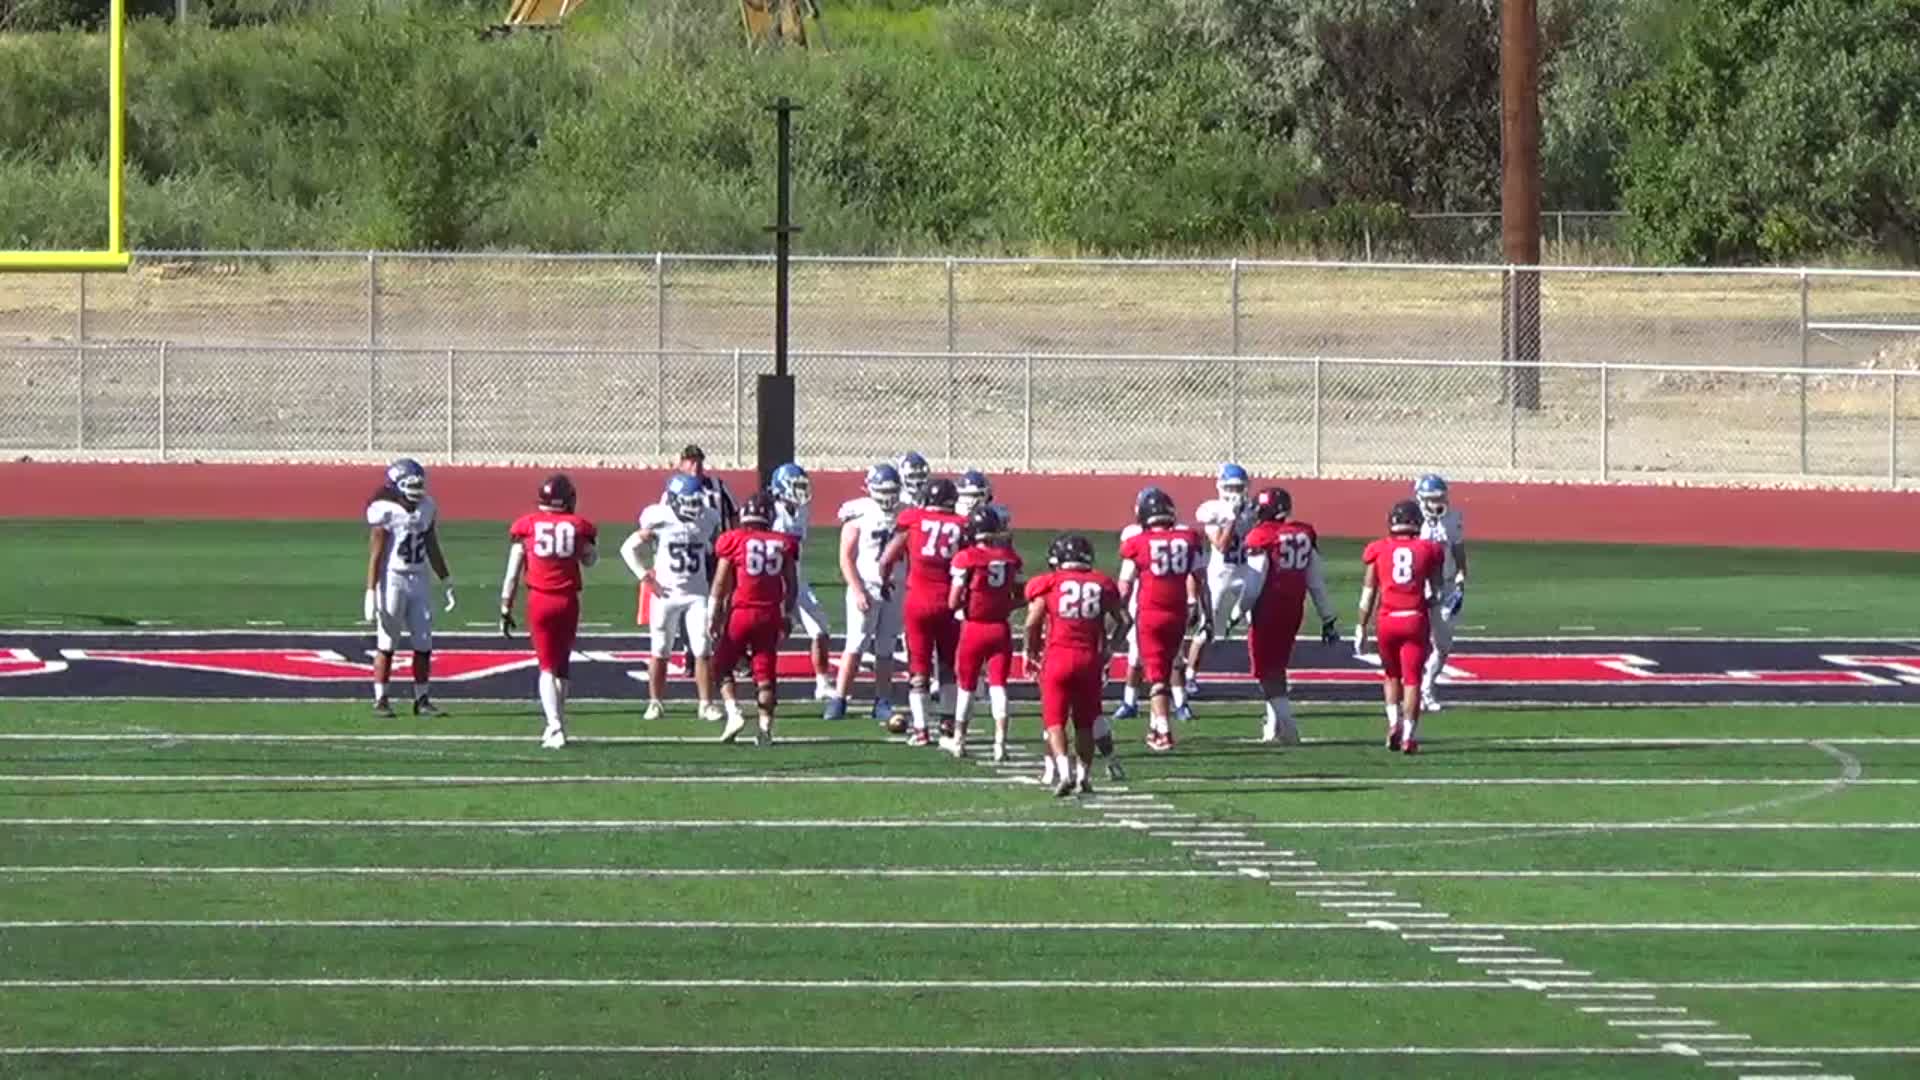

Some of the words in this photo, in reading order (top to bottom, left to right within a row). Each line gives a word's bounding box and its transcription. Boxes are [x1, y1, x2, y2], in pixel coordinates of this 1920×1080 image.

[533, 521, 576, 558] 50
[668, 541, 704, 574] 55
[745, 538, 785, 576] 65
[921, 519, 961, 558] 73
[1149, 537, 1189, 576] 58
[1278, 532, 1311, 570] 52
[1391, 546, 1413, 585] 8
[1058, 580, 1102, 619] 28
